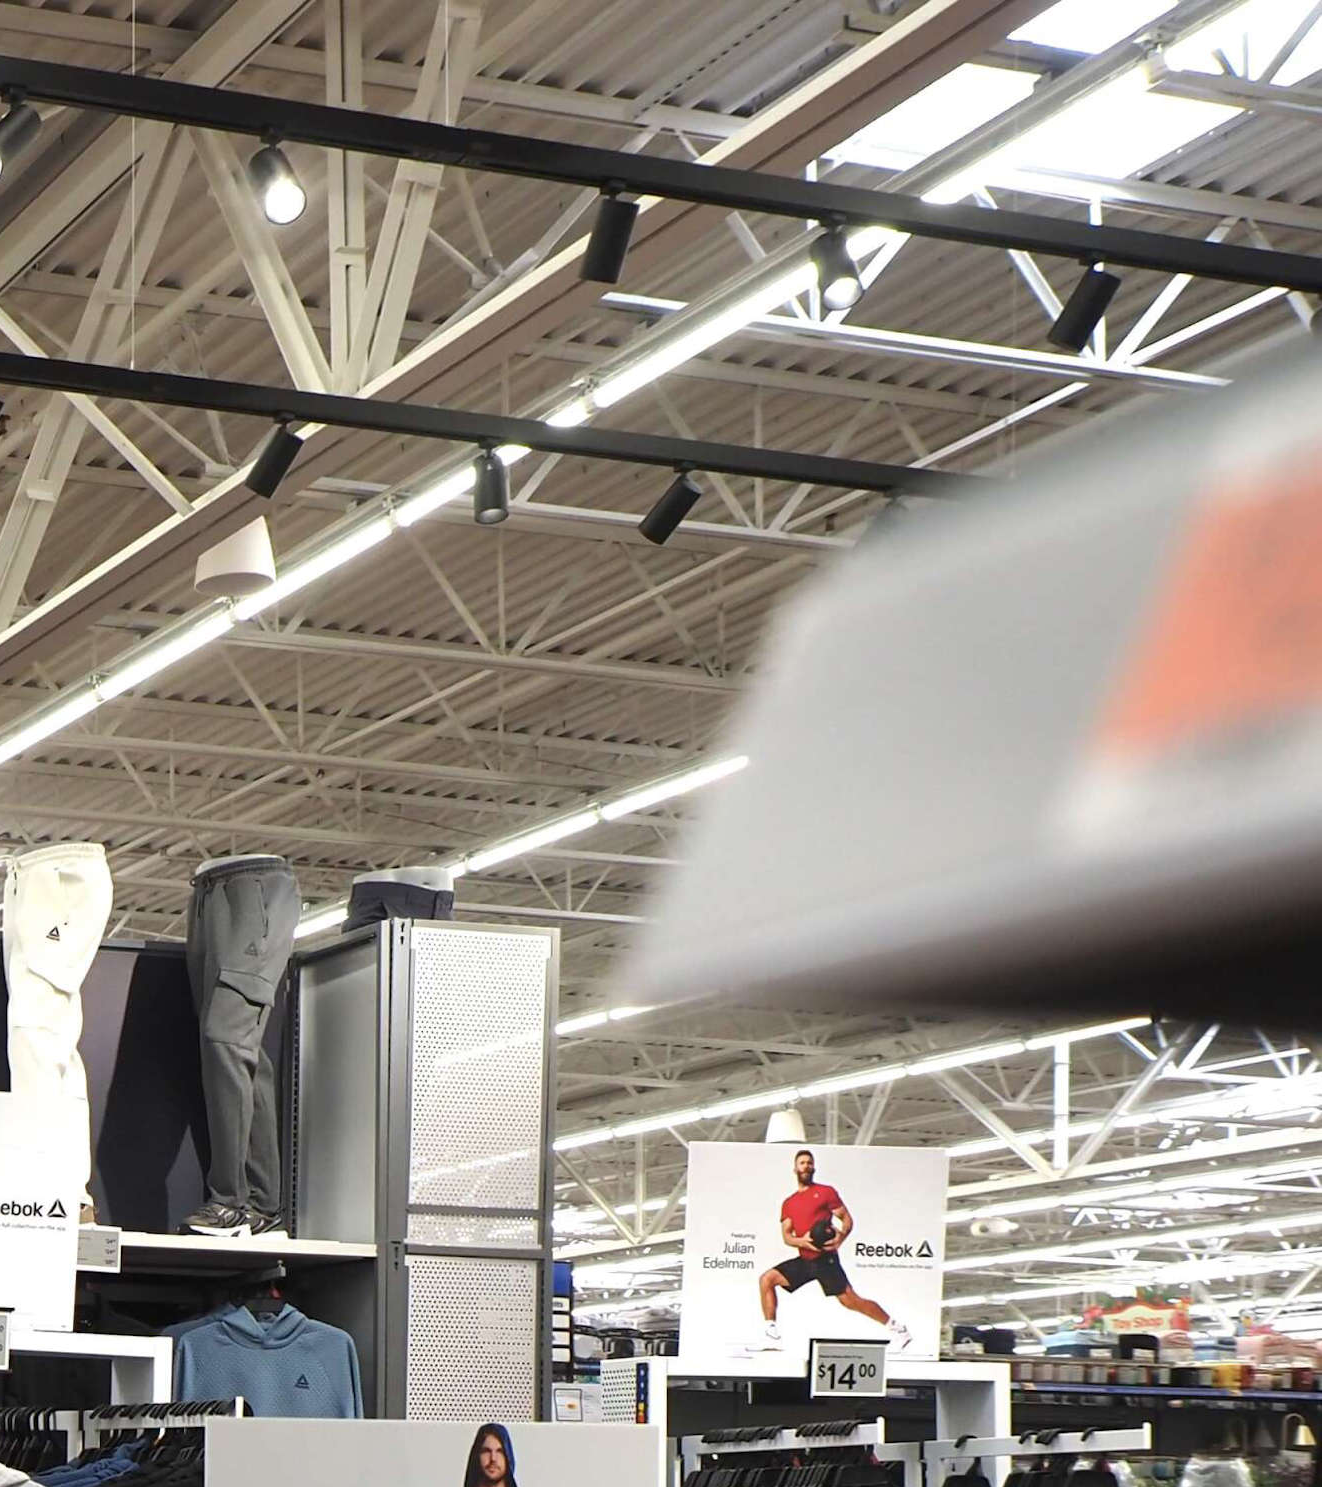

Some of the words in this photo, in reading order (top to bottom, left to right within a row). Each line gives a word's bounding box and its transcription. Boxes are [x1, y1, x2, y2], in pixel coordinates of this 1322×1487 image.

[722, 1241, 755, 1255] Julian
[855, 1242, 913, 1258] Reebok
[703, 1257, 755, 1270] Edelman
